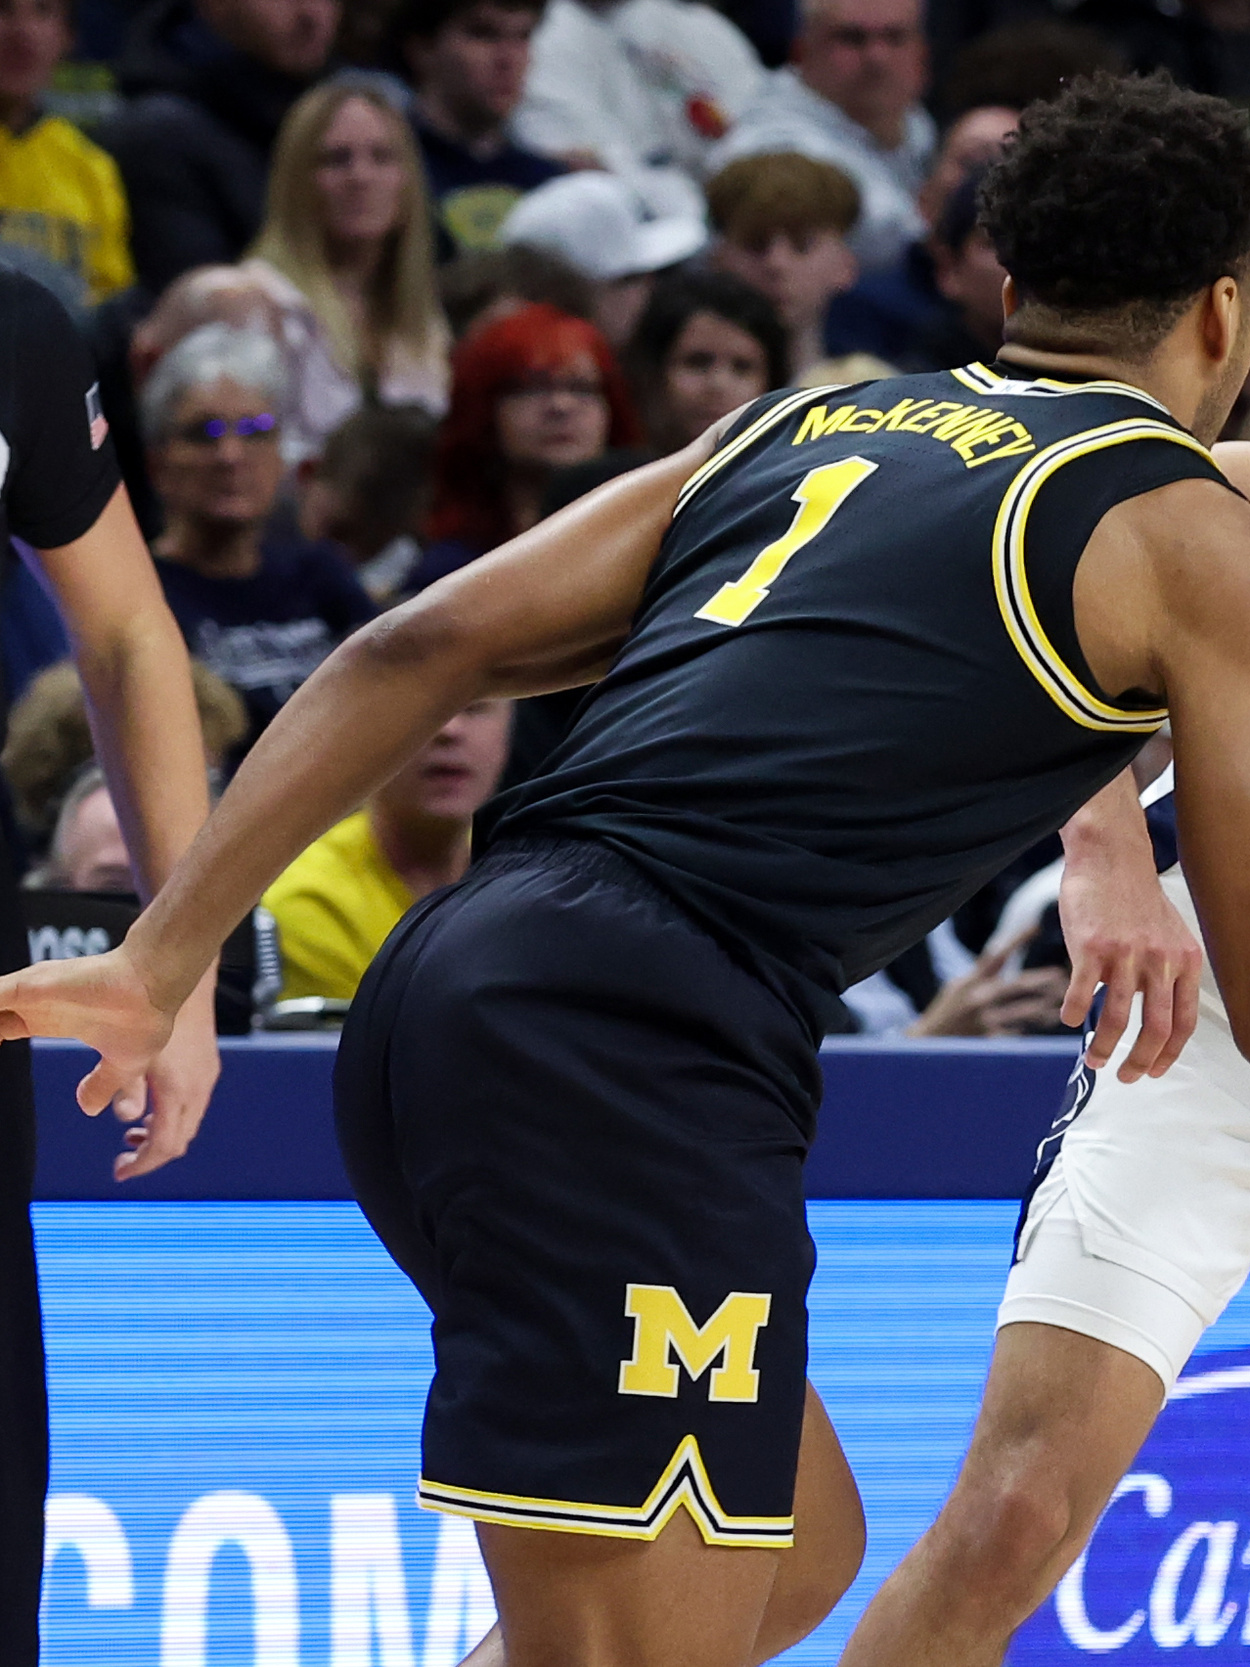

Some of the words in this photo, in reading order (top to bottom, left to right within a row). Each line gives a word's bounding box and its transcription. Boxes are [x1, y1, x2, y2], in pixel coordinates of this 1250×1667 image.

[792, 398, 1036, 469] McKENNEY
[693, 455, 880, 628] 1
[618, 1283, 772, 1403] M
